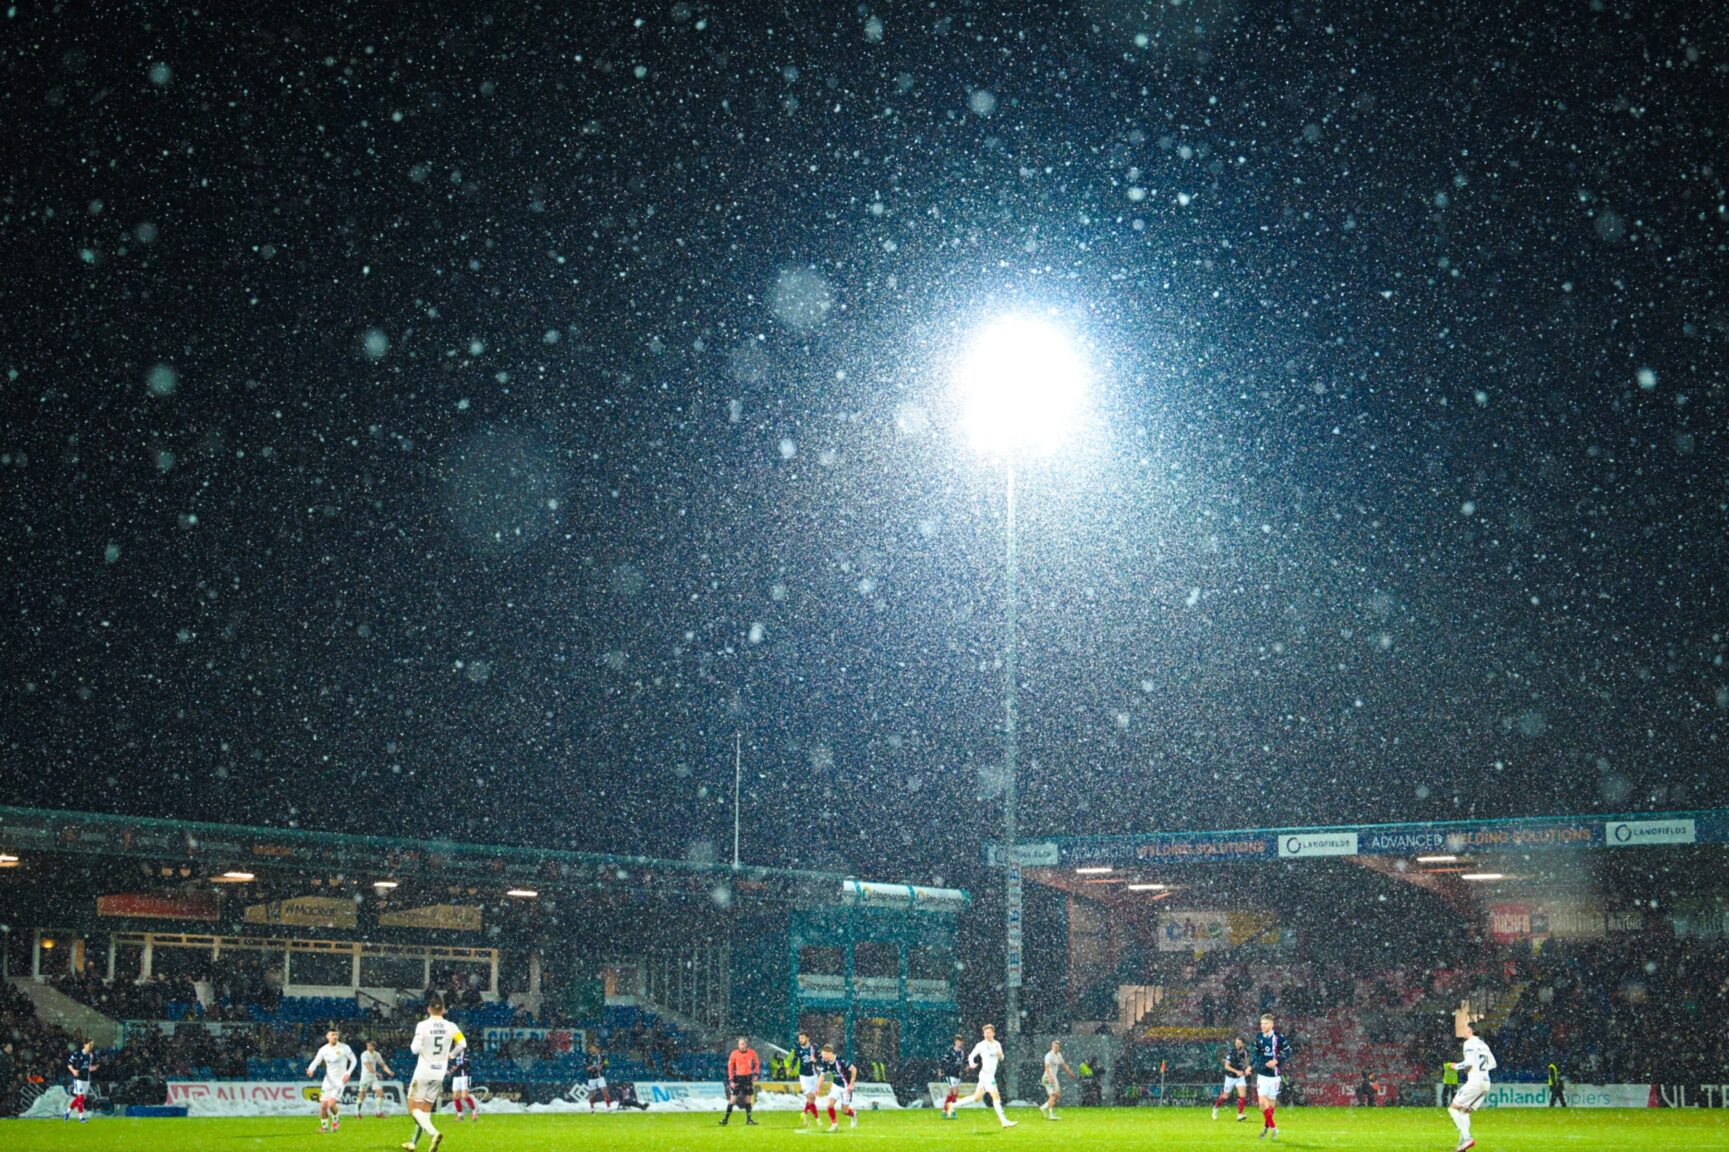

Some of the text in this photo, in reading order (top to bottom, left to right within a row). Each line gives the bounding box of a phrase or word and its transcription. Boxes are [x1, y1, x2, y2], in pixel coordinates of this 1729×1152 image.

[1371, 828, 1592, 848] ADVANCED WELDING SOLUTIONS
[1633, 827, 1687, 836] LANGFIELDS
[1302, 840, 1350, 849] LANGFIELDS
[433, 1036, 443, 1056] 5
[216, 1086, 297, 1101] ALLOYS
